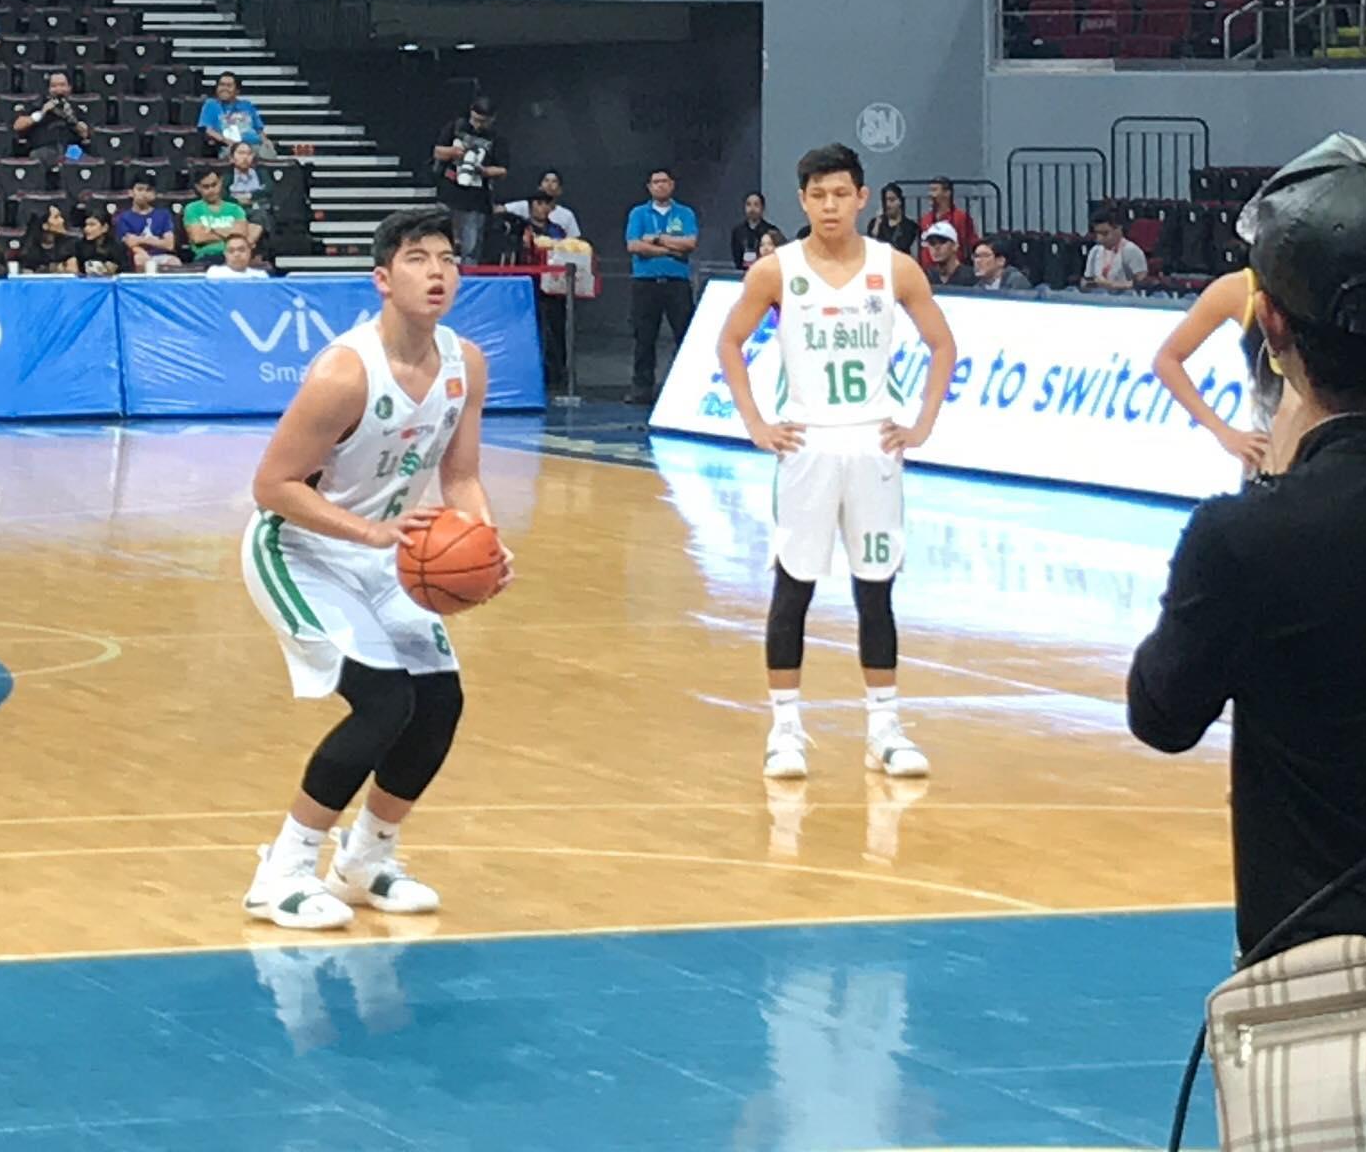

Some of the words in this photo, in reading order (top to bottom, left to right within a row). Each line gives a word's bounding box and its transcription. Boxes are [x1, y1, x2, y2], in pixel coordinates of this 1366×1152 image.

[230, 297, 371, 352] viv
[803, 321, 827, 351] La
[832, 321, 880, 351] Salle
[824, 359, 867, 405] 16
[980, 348, 1027, 408] to
[862, 532, 890, 563] 16
